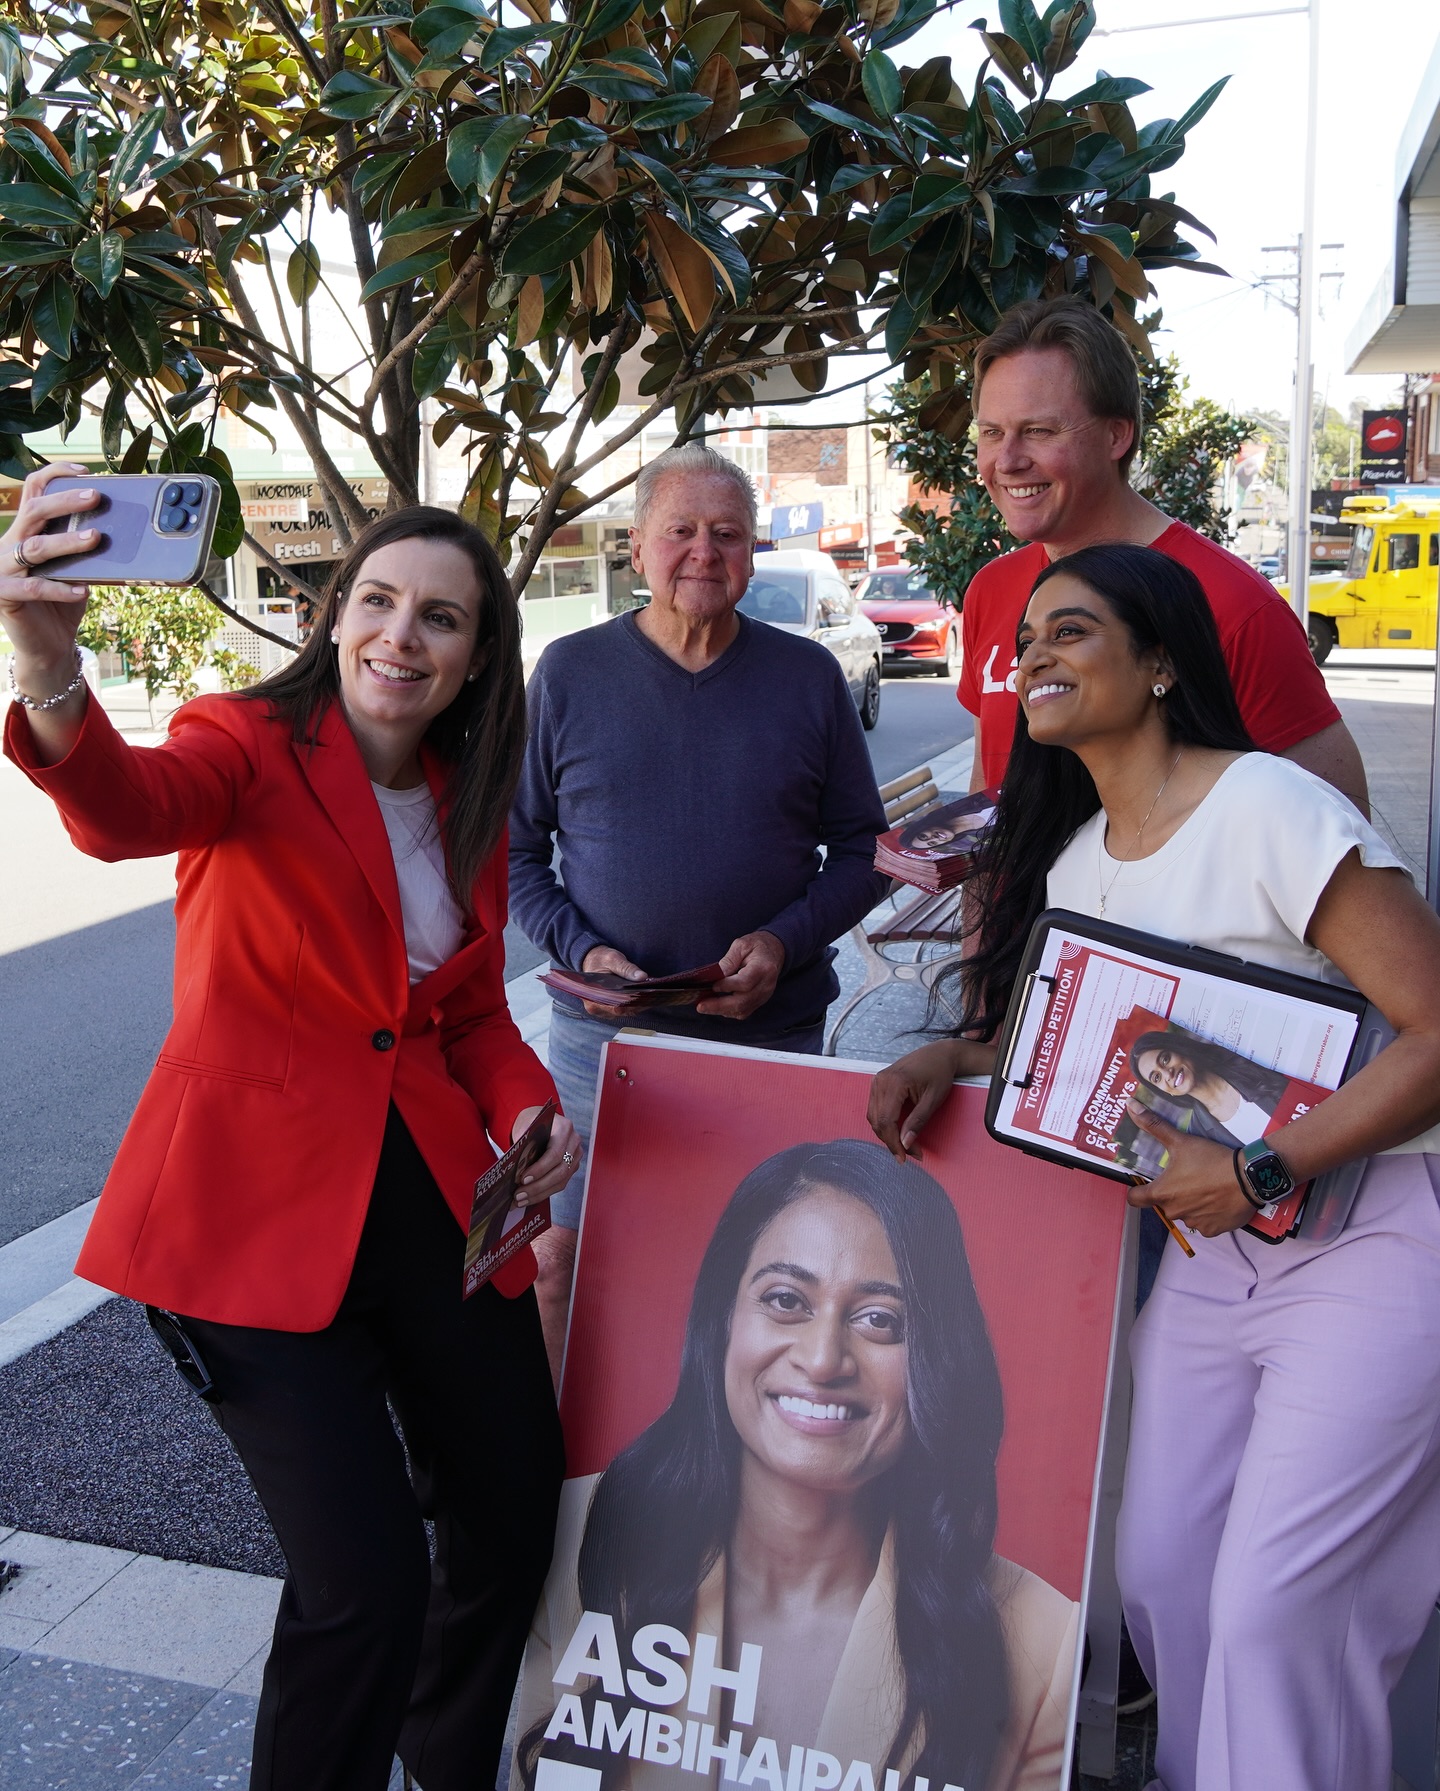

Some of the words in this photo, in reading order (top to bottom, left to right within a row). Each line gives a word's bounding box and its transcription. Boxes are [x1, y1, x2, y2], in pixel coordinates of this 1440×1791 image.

[257, 484, 313, 499] MORTDALE
[1361, 469, 1384, 480] Pizza
[1385, 470, 1403, 479] Hut
[274, 540, 321, 559] Fresh
[1025, 1032, 1056, 1109] TICKETLESS
[1048, 968, 1075, 1030] PETITION
[1083, 1047, 1127, 1124] COMMUNITY
[1092, 1093, 1119, 1130] FIRST.
[1103, 1081, 1138, 1135] ALWAYS.
[467, 1214, 541, 1284] AMBIHAIPAHAR
[467, 1250, 492, 1279] ASH
[551, 1610, 763, 1727] ASH
[543, 1693, 965, 1791] AMBIHAIPA
